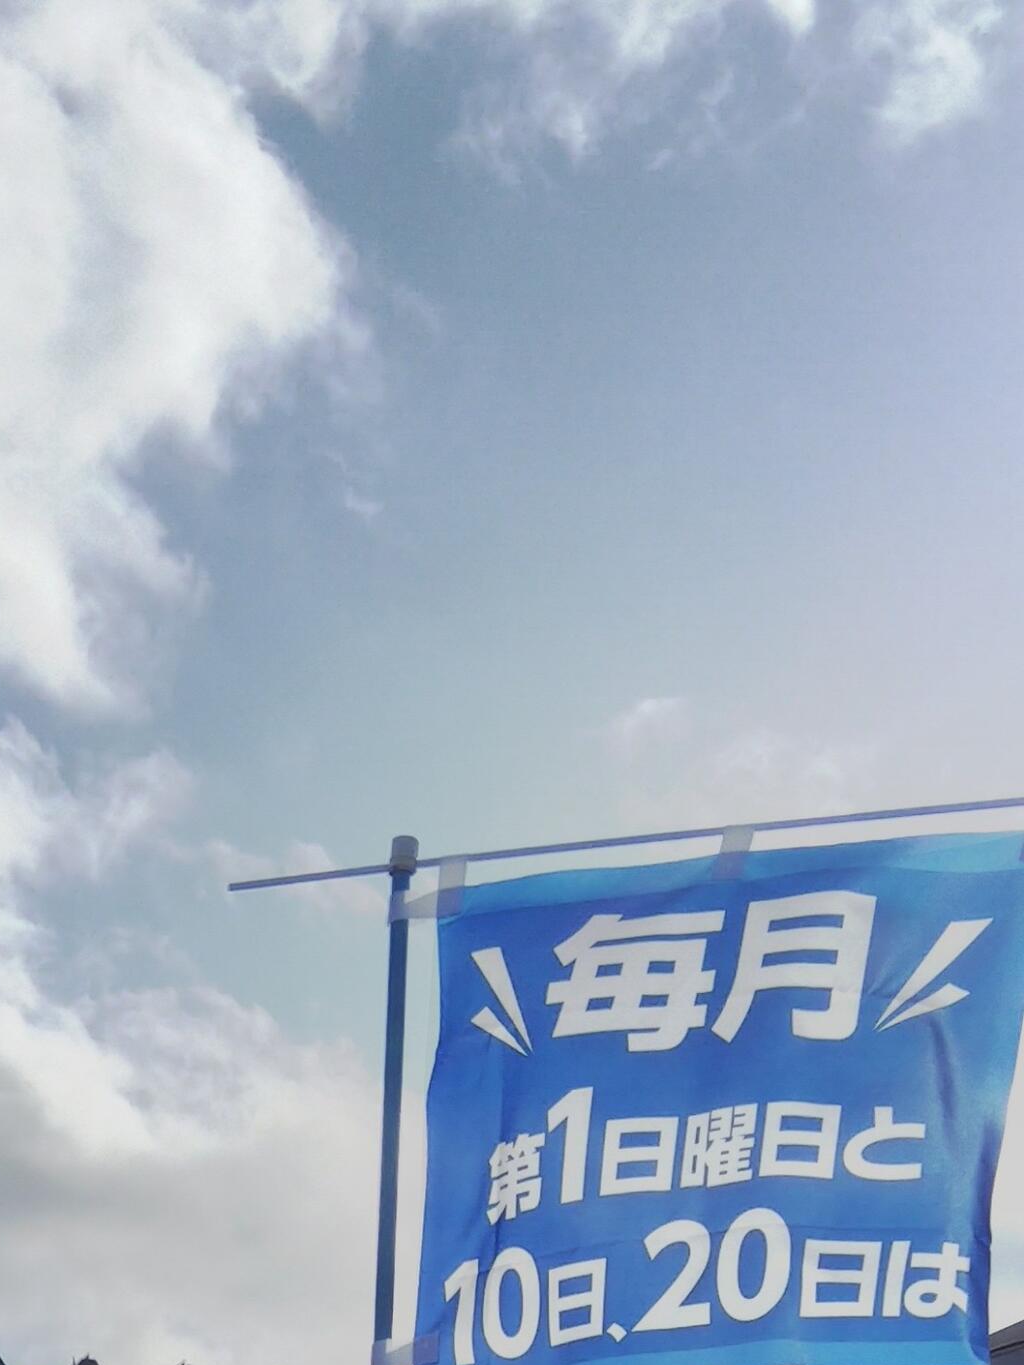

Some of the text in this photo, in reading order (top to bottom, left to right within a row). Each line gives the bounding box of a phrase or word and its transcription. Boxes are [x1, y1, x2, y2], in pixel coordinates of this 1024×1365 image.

[544, 890, 878, 1053] 毎月
[486, 1086, 926, 1225] 第1日曜日と
